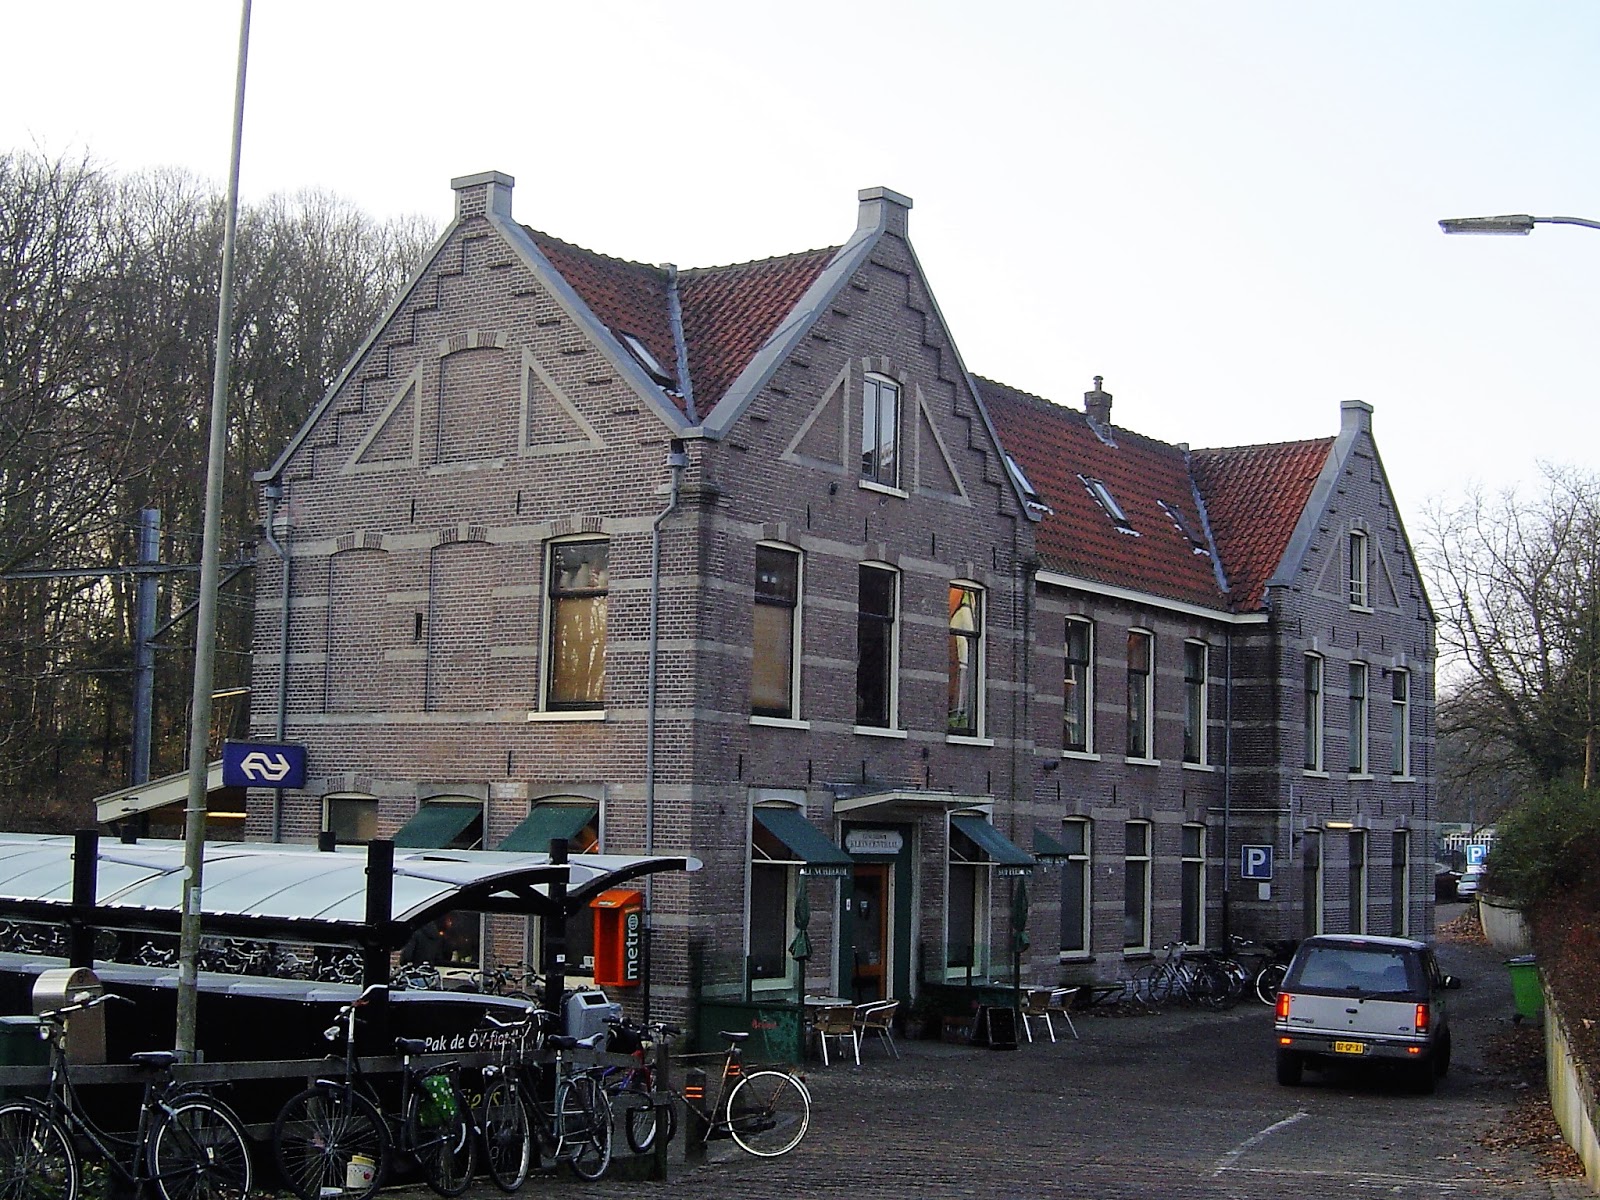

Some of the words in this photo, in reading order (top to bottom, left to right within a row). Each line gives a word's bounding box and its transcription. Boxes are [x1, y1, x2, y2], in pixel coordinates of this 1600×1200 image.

[1248, 848, 1266, 875] P
[1471, 847, 1482, 862] P
[626, 914, 639, 980] metro
[424, 1035, 447, 1052] Pak
[450, 1034, 465, 1050] de
